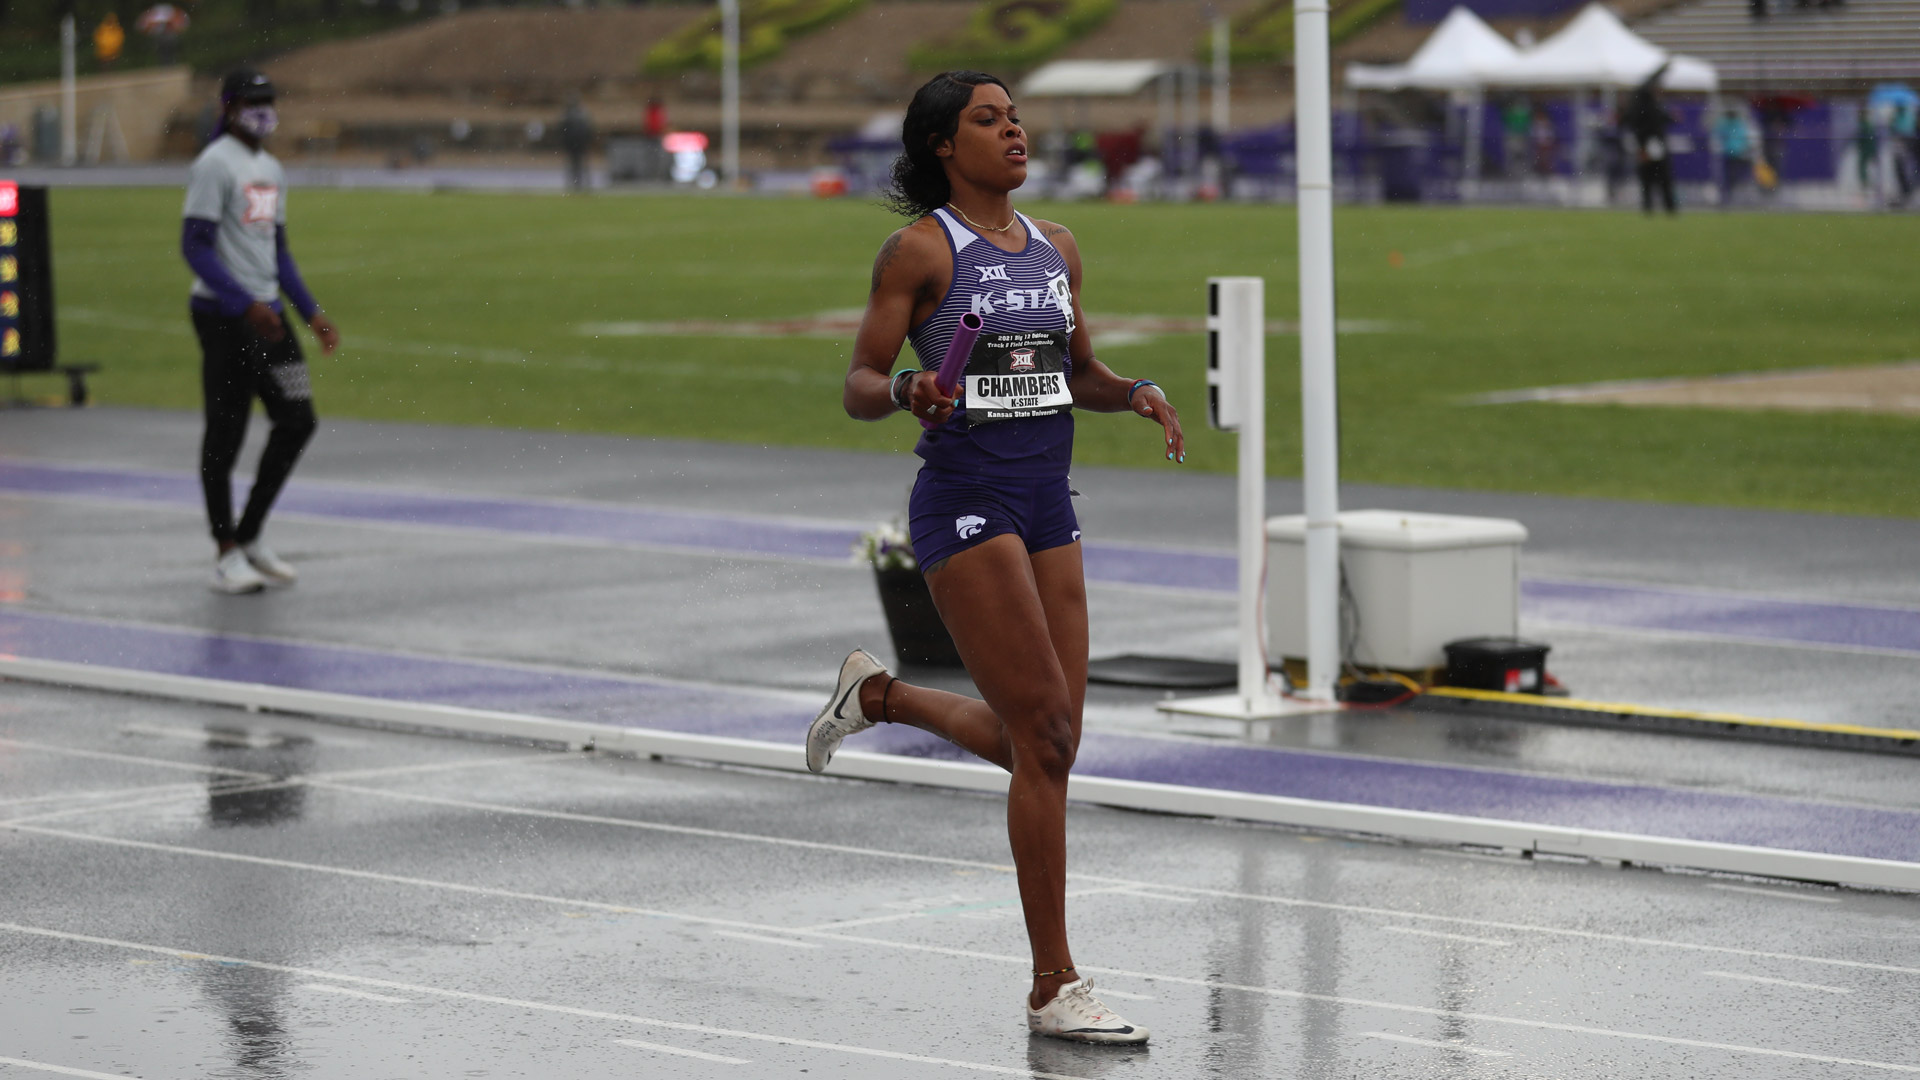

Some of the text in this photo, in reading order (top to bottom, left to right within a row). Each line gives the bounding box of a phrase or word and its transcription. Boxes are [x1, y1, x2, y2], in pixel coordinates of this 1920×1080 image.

[974, 264, 1013, 283] XII
[1014, 334, 1023, 342] Big
[977, 374, 1061, 397] CHAMBERS
[1011, 397, 1039, 408] K-STATE
[1031, 409, 1059, 417] University
